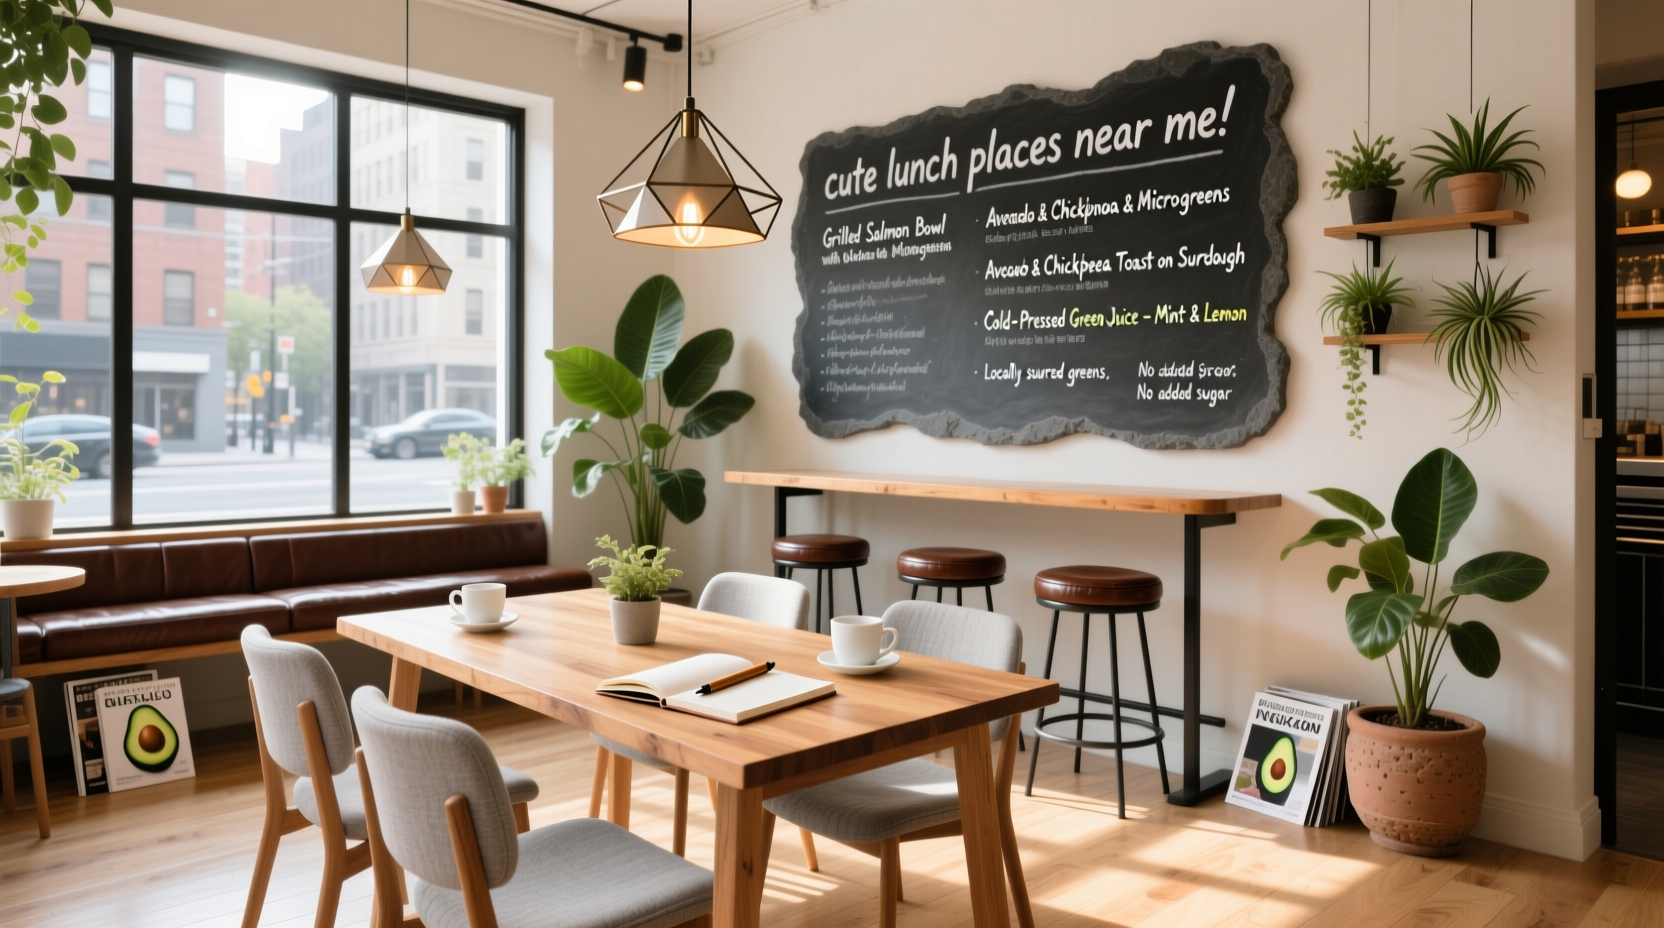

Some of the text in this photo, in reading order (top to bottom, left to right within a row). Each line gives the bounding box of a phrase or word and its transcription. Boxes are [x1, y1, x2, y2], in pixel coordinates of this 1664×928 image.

[824, 84, 1236, 200] cute lunch places near me!
[1037, 203, 1048, 222] &
[1122, 193, 1133, 213] &
[1137, 187, 1230, 216] Microgreens
[823, 212, 947, 248] Grilled Salmon Bowl
[1031, 258, 1041, 277] &
[1115, 250, 1155, 272] Toast
[1157, 255, 1173, 268] on
[984, 307, 1066, 331] Cold-Pressed
[1069, 307, 1104, 328] Green
[1105, 306, 1139, 327] Juice
[1154, 303, 1187, 324] Mint
[1189, 303, 1200, 323] &
[1203, 301, 1247, 323] Lemon
[1138, 360, 1155, 378] No
[1137, 382, 1153, 400] No
[1196, 387, 1233, 408] sugar
